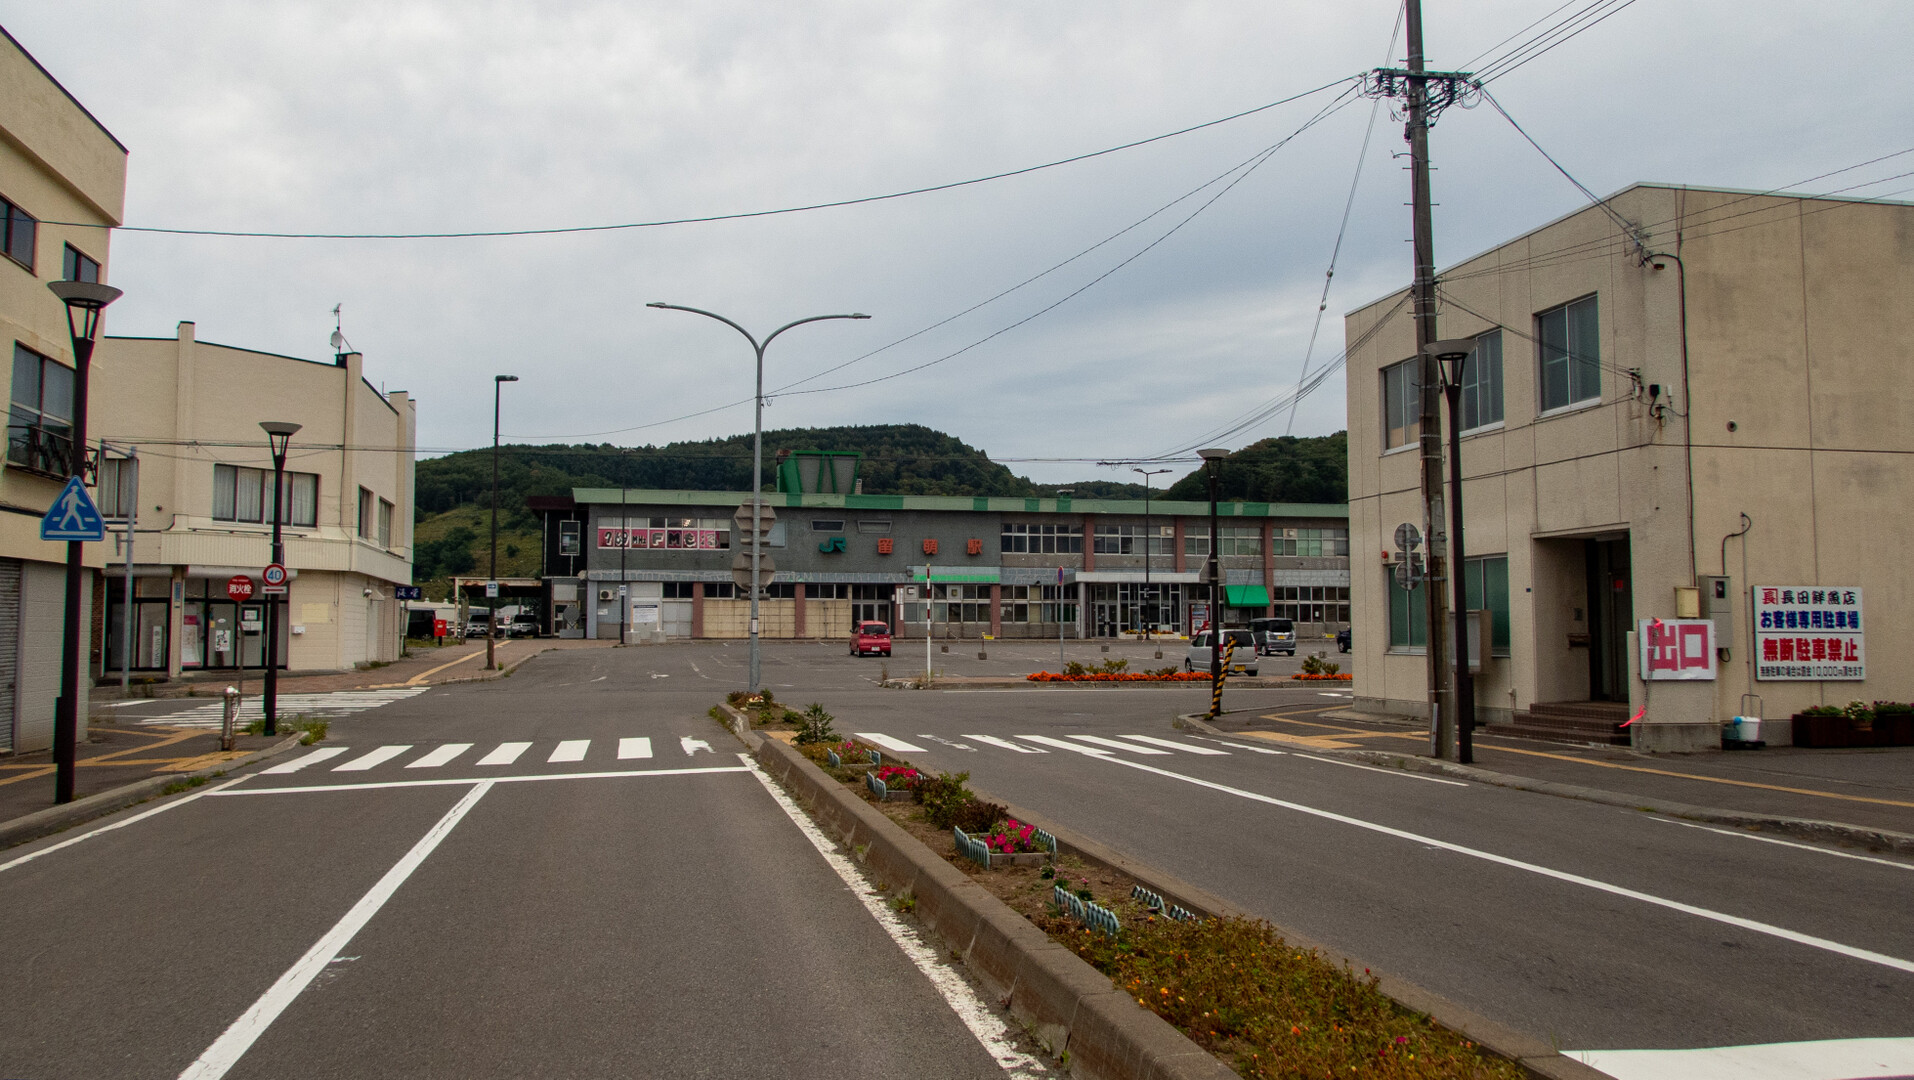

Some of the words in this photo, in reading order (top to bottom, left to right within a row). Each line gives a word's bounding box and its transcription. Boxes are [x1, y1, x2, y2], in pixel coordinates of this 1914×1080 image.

[819, 537, 846, 553] JR
[267, 570, 282, 580] 40
[228, 584, 252, 594] 消火栓
[1781, 590, 1856, 605] 長田鮮魚店
[1760, 610, 1859, 629] お客様専用駐車場
[1646, 623, 1710, 671] 出口
[1763, 637, 1859, 662] 無断駐車禁止
